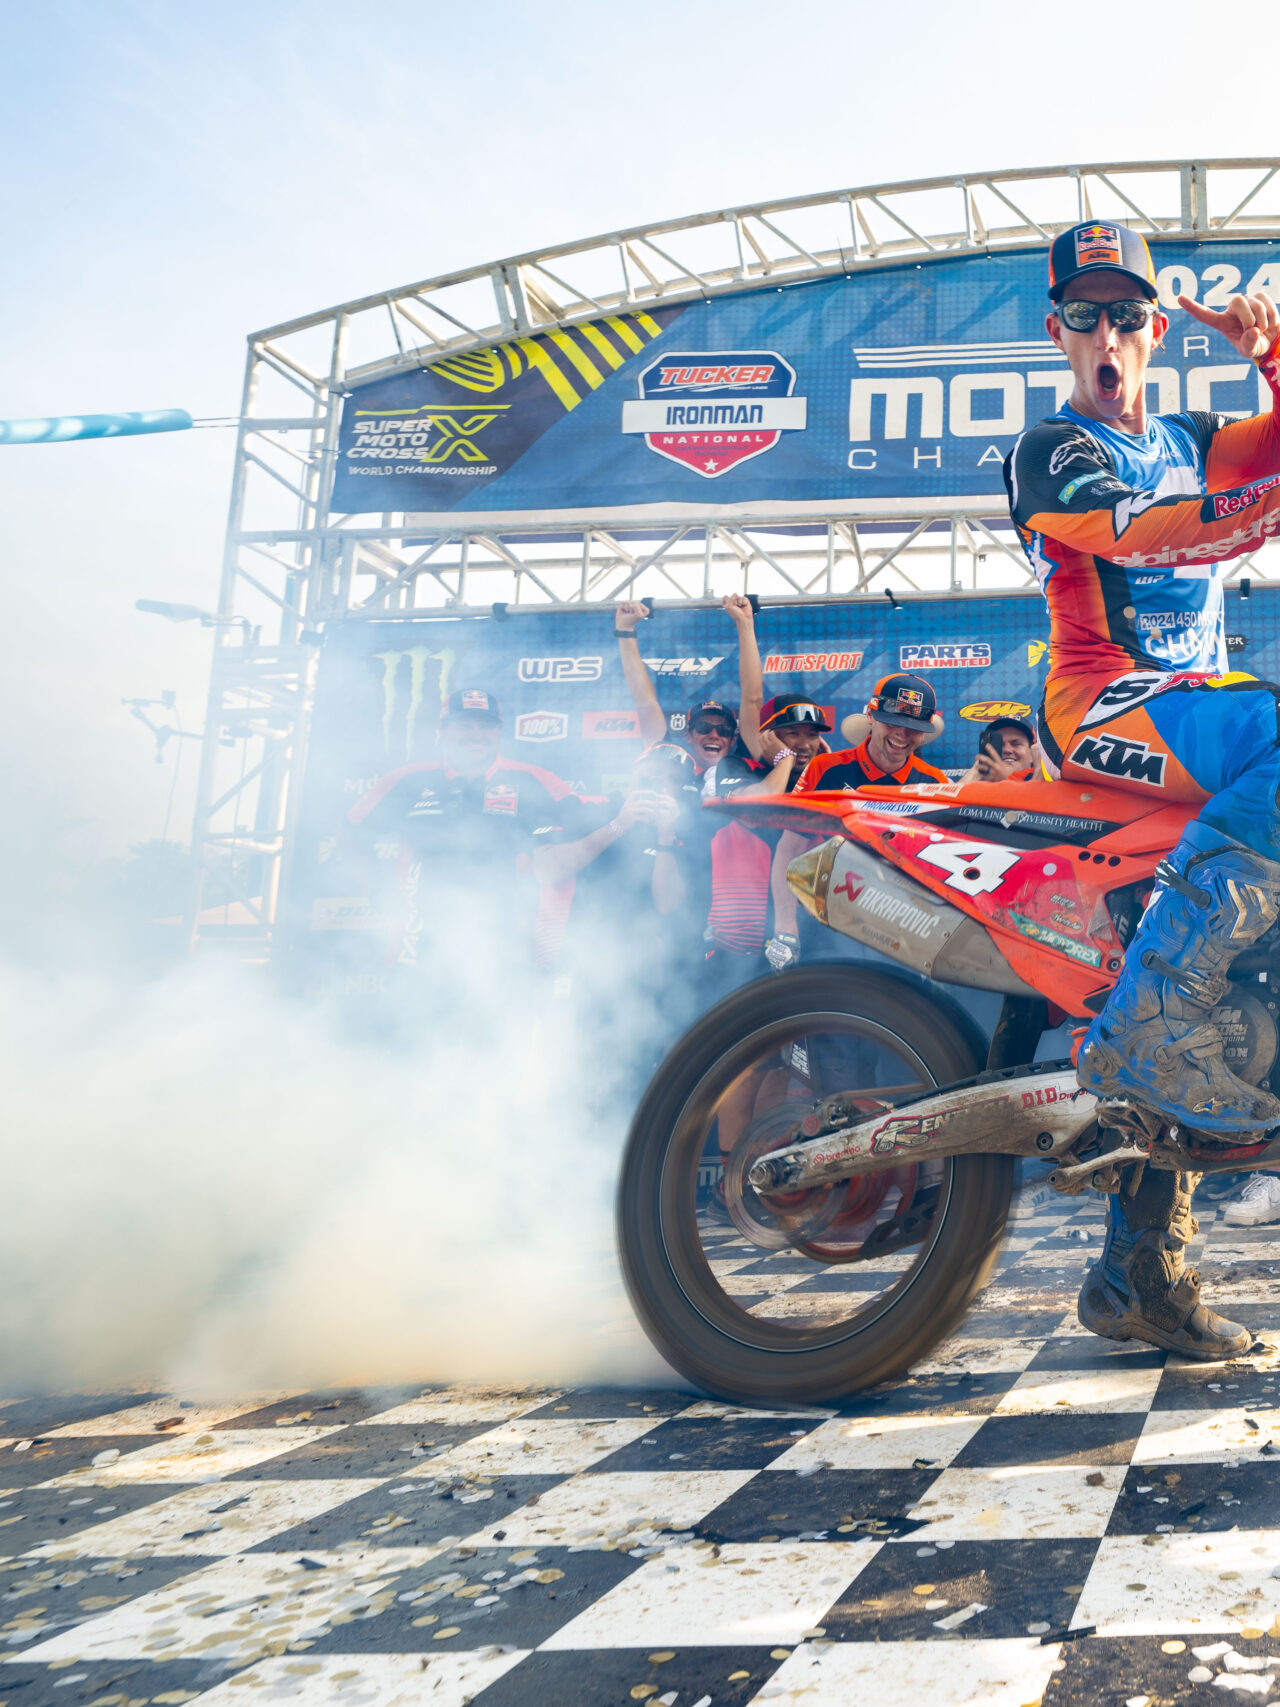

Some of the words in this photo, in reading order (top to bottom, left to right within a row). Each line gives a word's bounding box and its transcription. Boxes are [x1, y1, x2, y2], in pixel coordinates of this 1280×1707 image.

[659, 365, 775, 385] TUCKER
[666, 405, 763, 426] IRONMAN
[352, 419, 433, 433] SUPER
[355, 433, 428, 447] MOTO
[663, 434, 764, 444] NATIONAL
[346, 447, 430, 460] CROSS
[348, 466, 393, 476] WORLD
[394, 465, 498, 476] CHAMPIONSHIP
[1213, 485, 1253, 519] Red
[1142, 614, 1173, 629] 2024
[1176, 611, 1197, 628] 450
[901, 643, 990, 660] PARTS
[517, 656, 604, 682] WPS
[901, 657, 991, 670] UNLIMITED
[961, 703, 1031, 718] FMF
[523, 719, 561, 735] 100%
[594, 717, 636, 732] KTM
[1070, 734, 1166, 786] KTM
[861, 800, 920, 814] PROGRESSIVE
[959, 807, 984, 818] LOMA
[984, 810, 1006, 820] LIND
[1065, 817, 1103, 832] HEALTH
[915, 841, 1022, 897] 4
